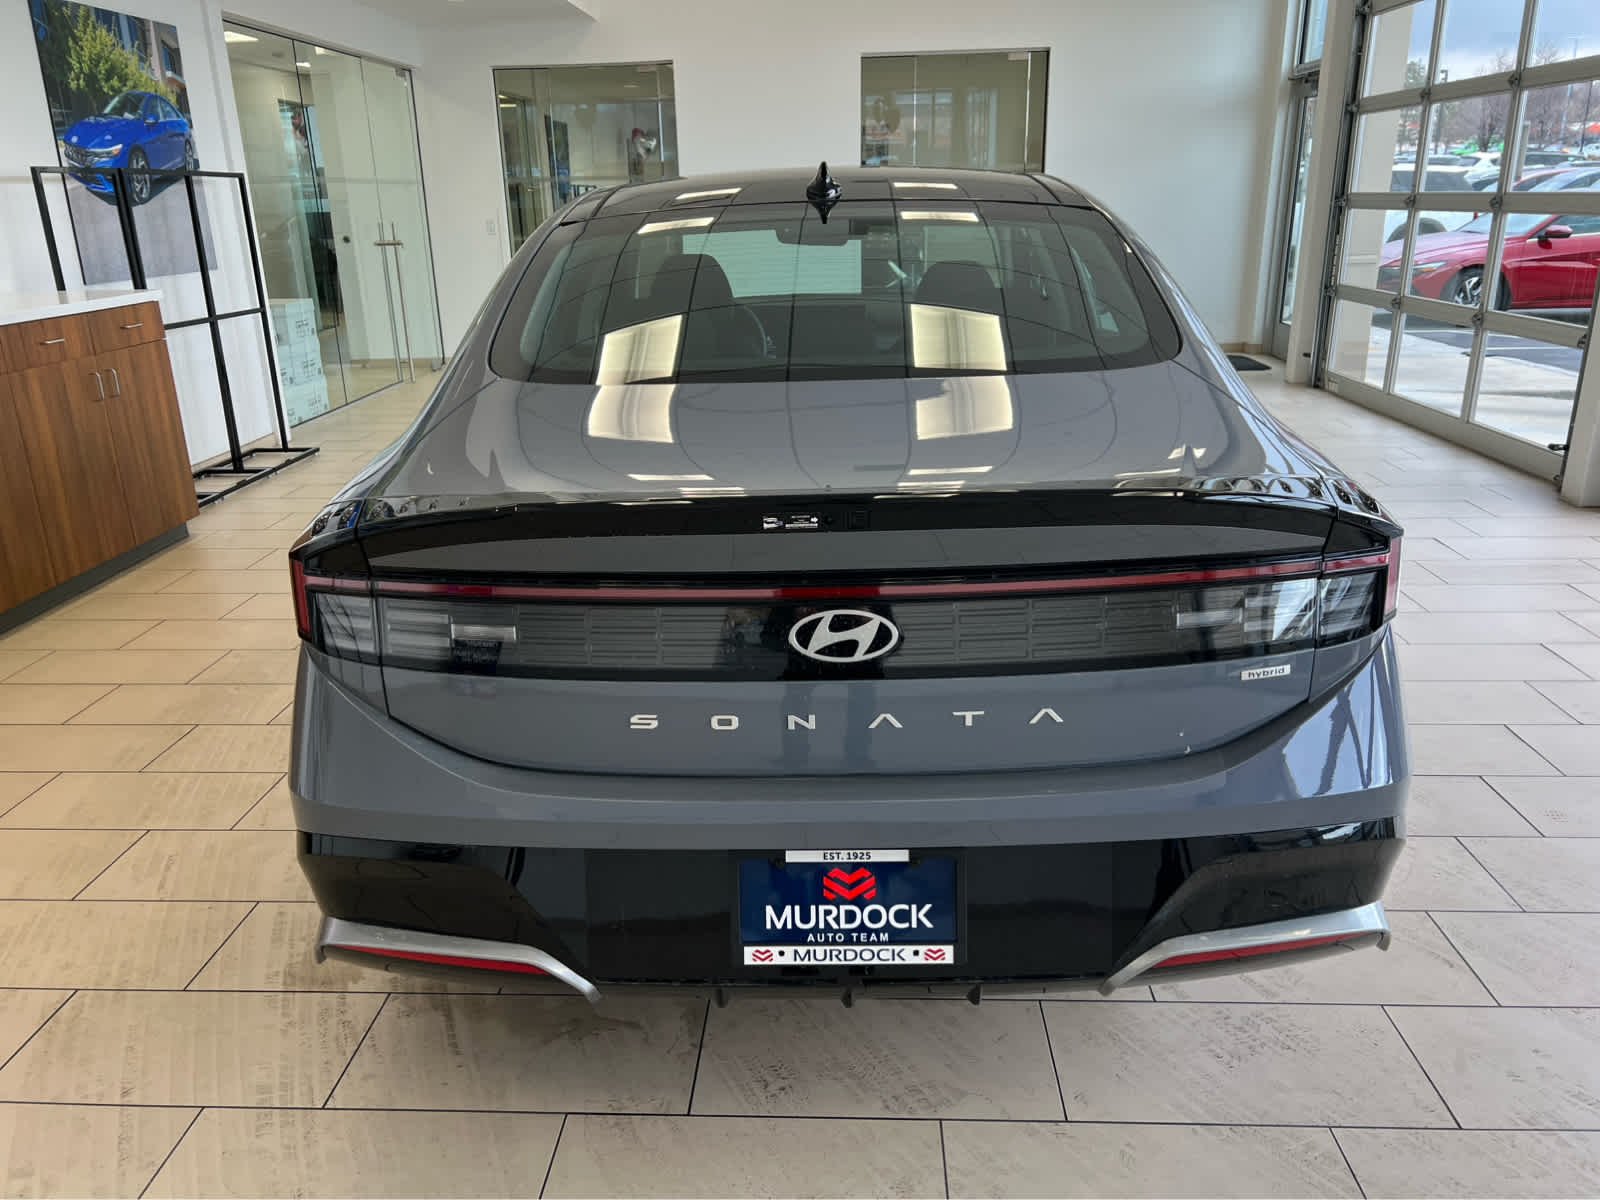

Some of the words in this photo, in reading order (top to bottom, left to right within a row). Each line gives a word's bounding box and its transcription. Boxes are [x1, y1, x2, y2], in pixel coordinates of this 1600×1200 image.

[1247, 666, 1285, 679] hybrid
[629, 707, 1064, 731] SONATA
[823, 851, 844, 861] EST.
[846, 851, 872, 861] 1925
[765, 903, 934, 930] MURDOCK
[807, 932, 845, 943] AUTO
[851, 932, 889, 943] TEAM
[793, 948, 906, 962] MURDOCK
